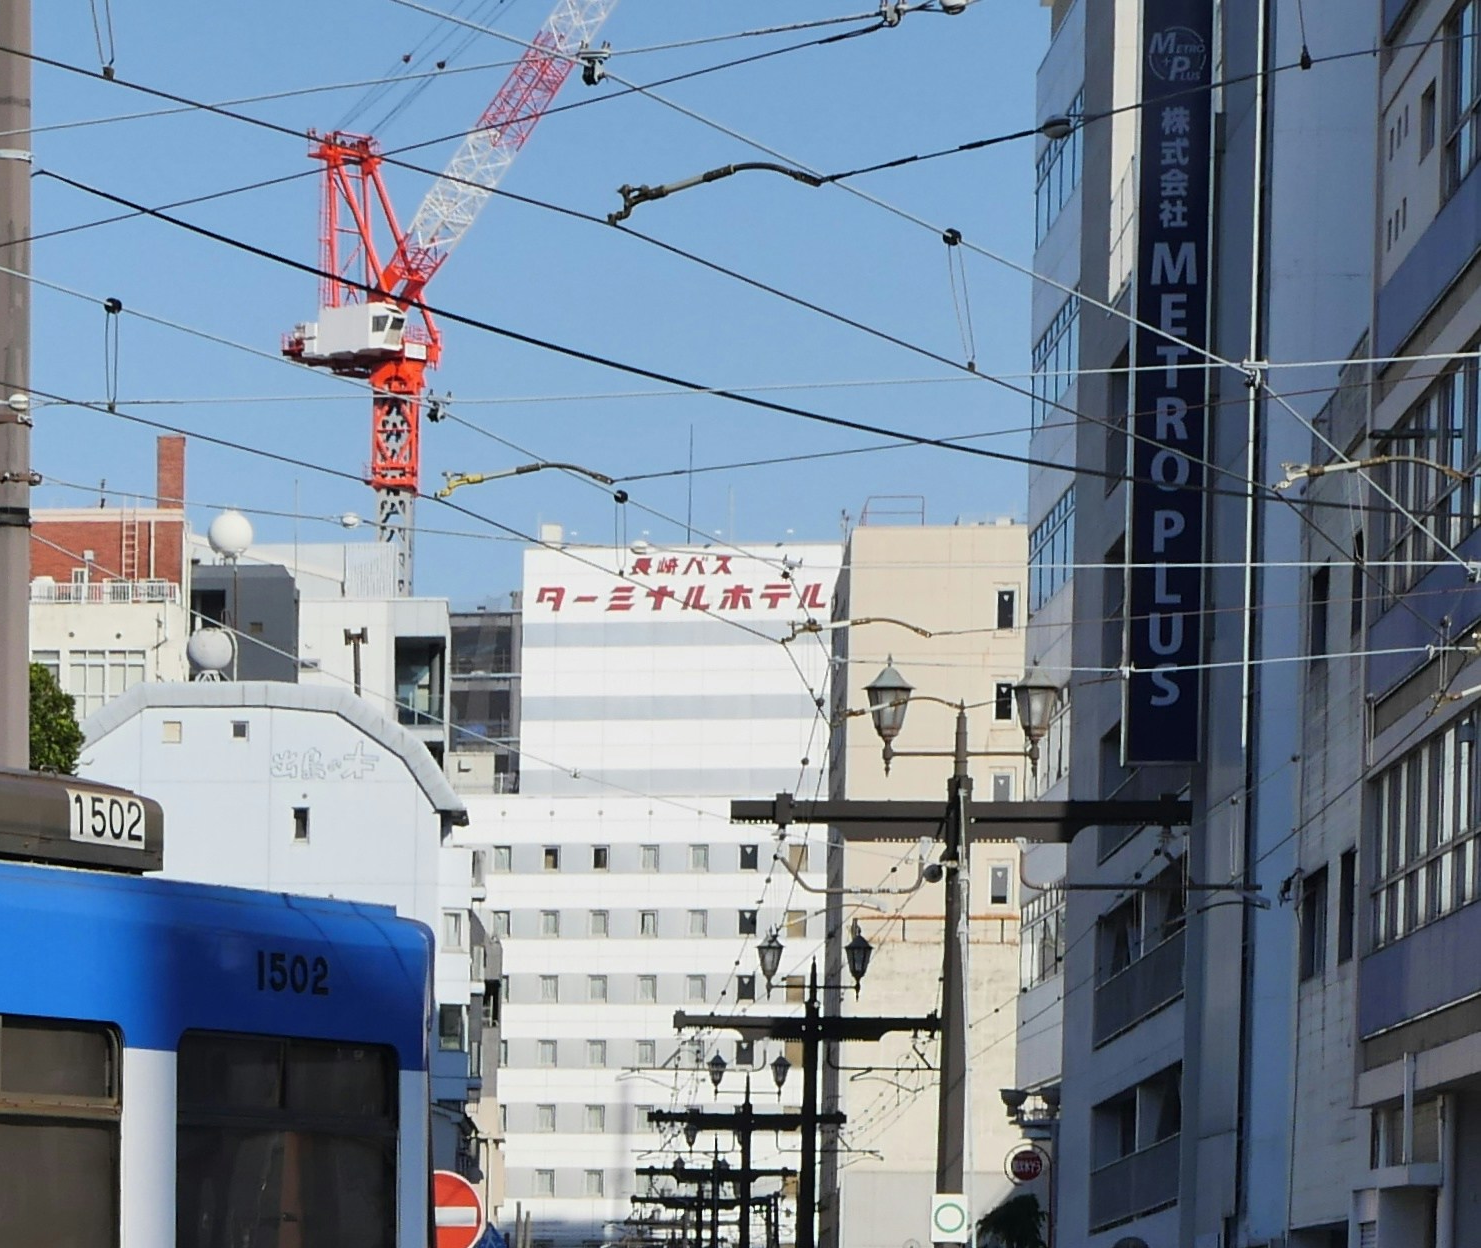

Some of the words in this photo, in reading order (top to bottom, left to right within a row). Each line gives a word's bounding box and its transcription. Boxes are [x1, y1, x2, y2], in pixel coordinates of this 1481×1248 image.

[1159, 105, 1191, 228] 株式会社
[1149, 241, 1198, 492] METRO
[629, 555, 733, 577] 長崎バス
[535, 582, 827, 613] ターミナルホテル
[1148, 509, 1186, 707] PLUS
[74, 792, 144, 842] 1502
[256, 950, 330, 996] 1502
